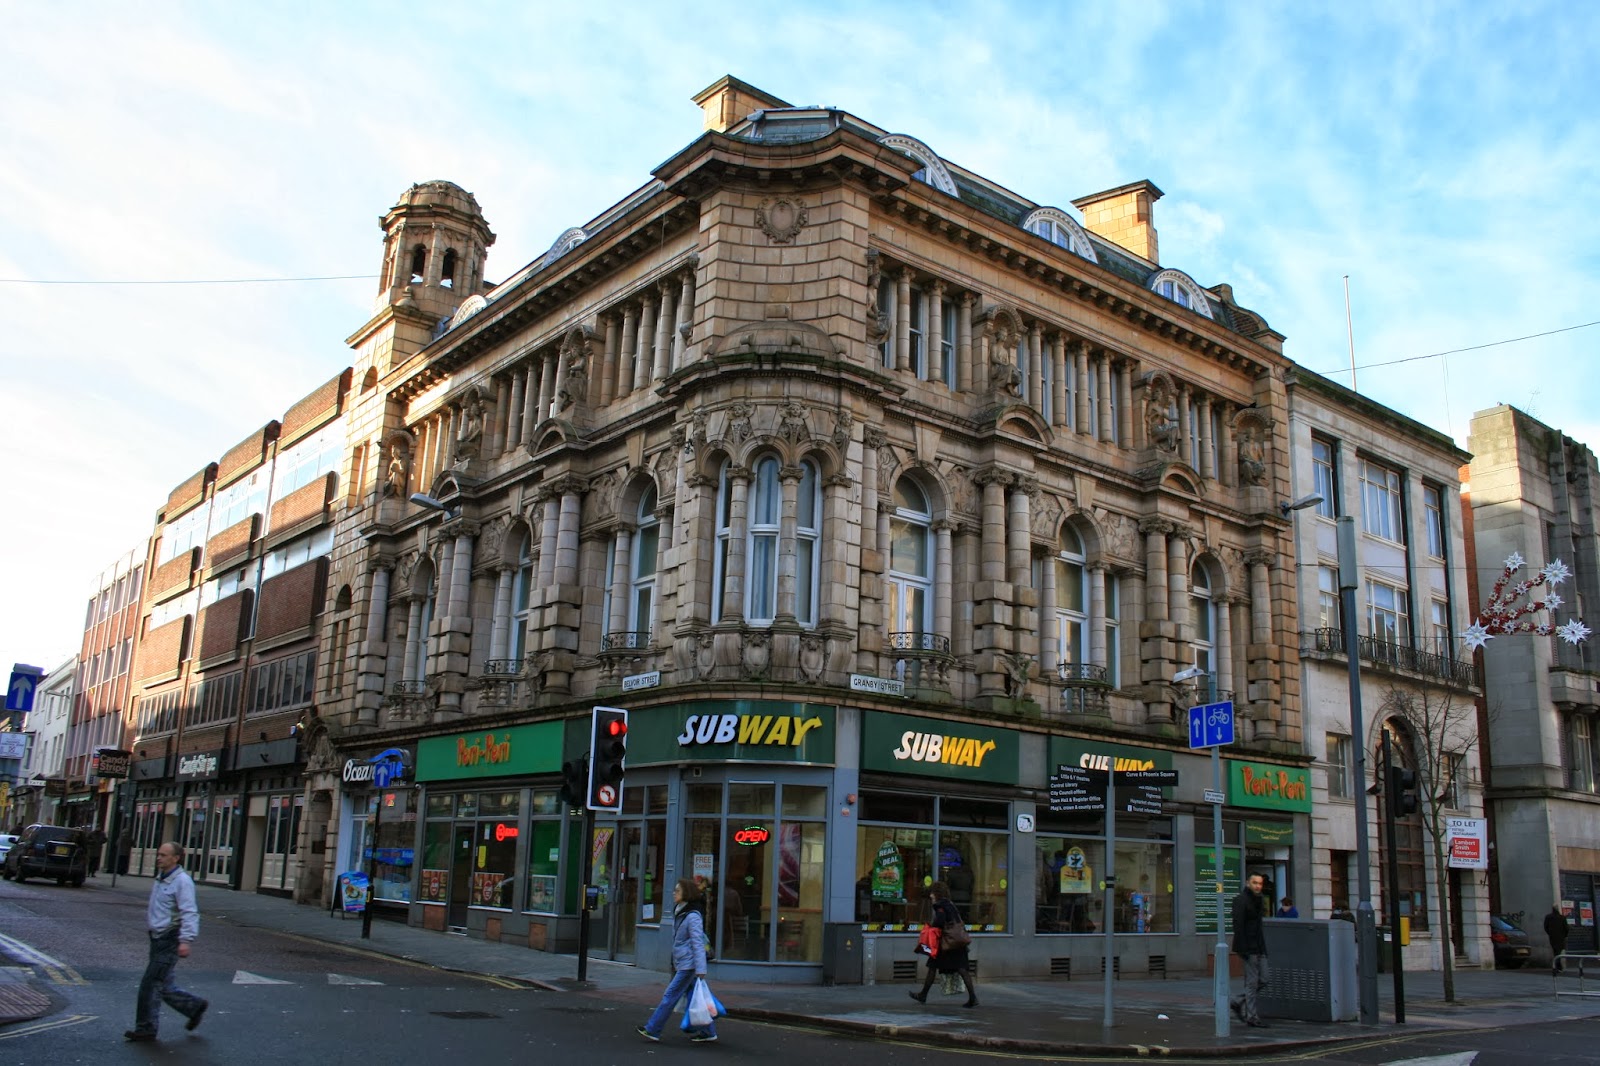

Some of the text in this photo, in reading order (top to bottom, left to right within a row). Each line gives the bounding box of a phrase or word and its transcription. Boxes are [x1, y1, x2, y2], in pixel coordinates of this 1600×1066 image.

[624, 675, 658, 688] BELVOIR STREET
[854, 678, 902, 692] GRANBY STREET
[677, 714, 822, 746] SUBWAY
[457, 734, 511, 767] Peri-Peri
[893, 731, 996, 767] SUBWAY
[100, 754, 128, 766] Candy
[100, 762, 126, 772] Stripe
[1242, 766, 1306, 801] Peri-Peri
[735, 830, 768, 842] OPEN
[879, 847, 895, 856] REAL
[882, 856, 899, 866] DEAL
